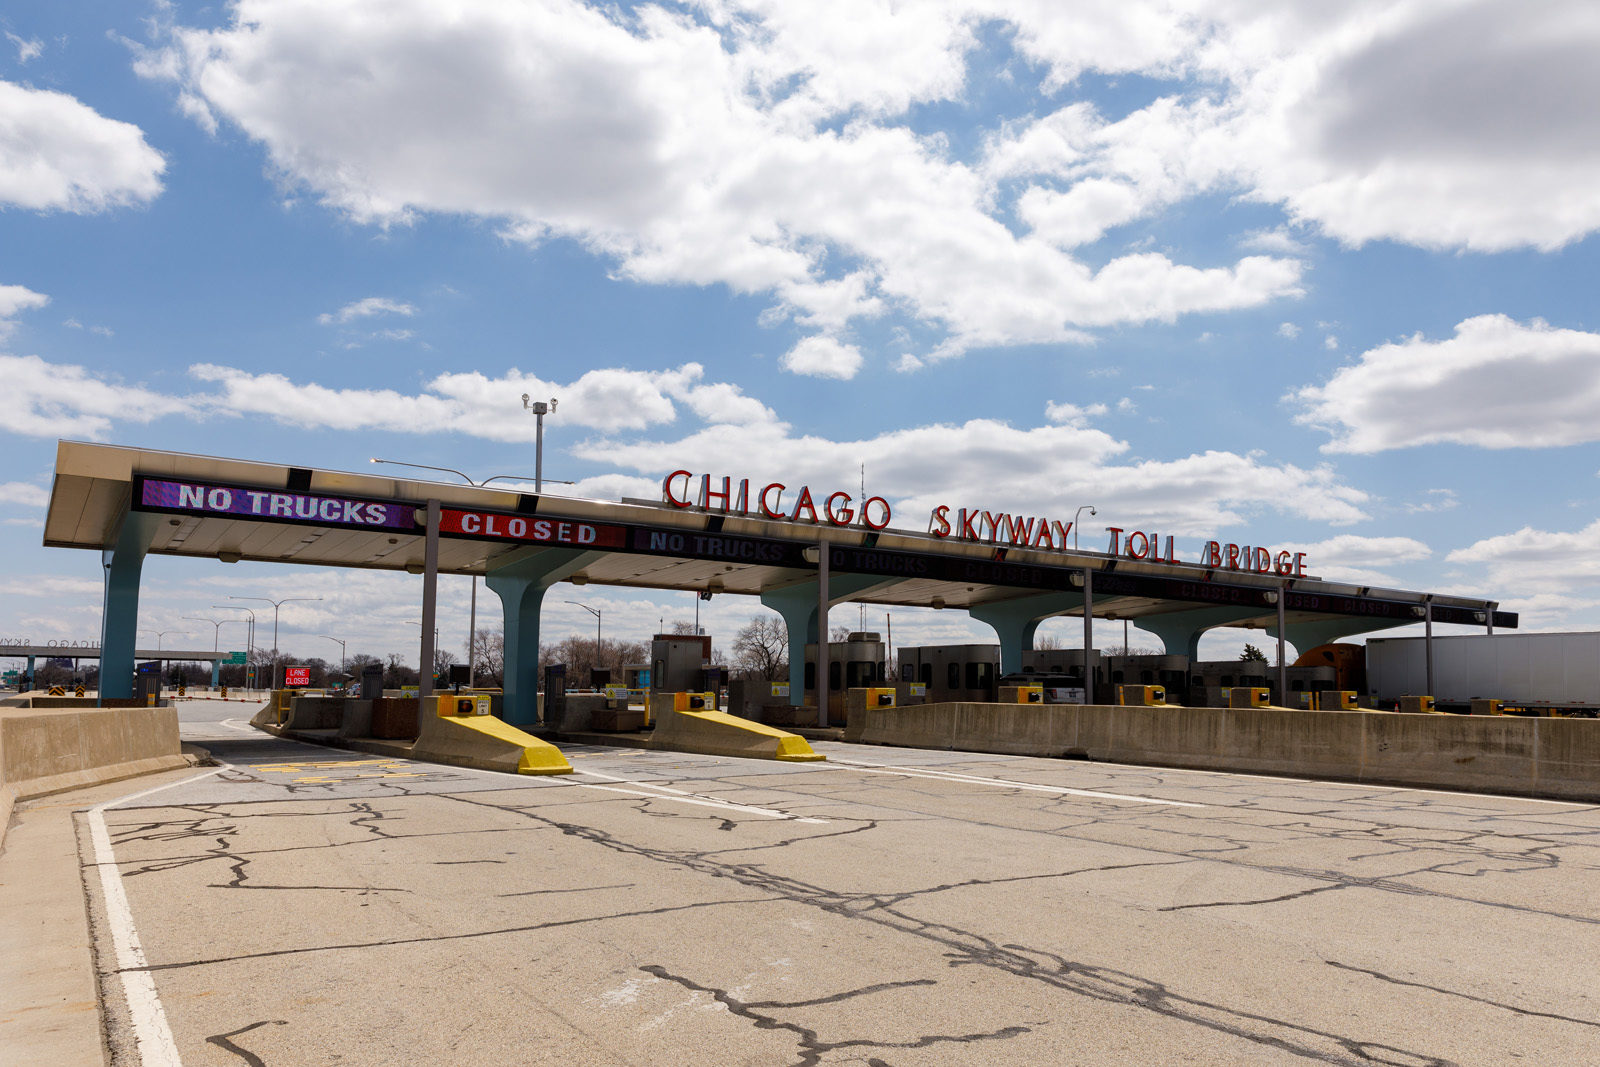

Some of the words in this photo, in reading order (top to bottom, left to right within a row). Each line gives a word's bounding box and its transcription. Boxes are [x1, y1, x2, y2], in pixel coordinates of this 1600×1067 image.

[178, 485, 232, 510] NO
[247, 491, 387, 525] TRUCKS
[461, 514, 596, 544] CLOSED
[663, 470, 891, 530] CHICAGO
[932, 505, 1073, 551] SKYWAY
[1106, 527, 1180, 563] TOLL
[1206, 541, 1307, 577] BRIDGE
[650, 532, 684, 551] NO
[694, 536, 783, 561] TRUCKS
[853, 552, 927, 573] TRUCKS
[285, 677, 309, 685] CLOSED
[290, 669, 306, 677] LANE
